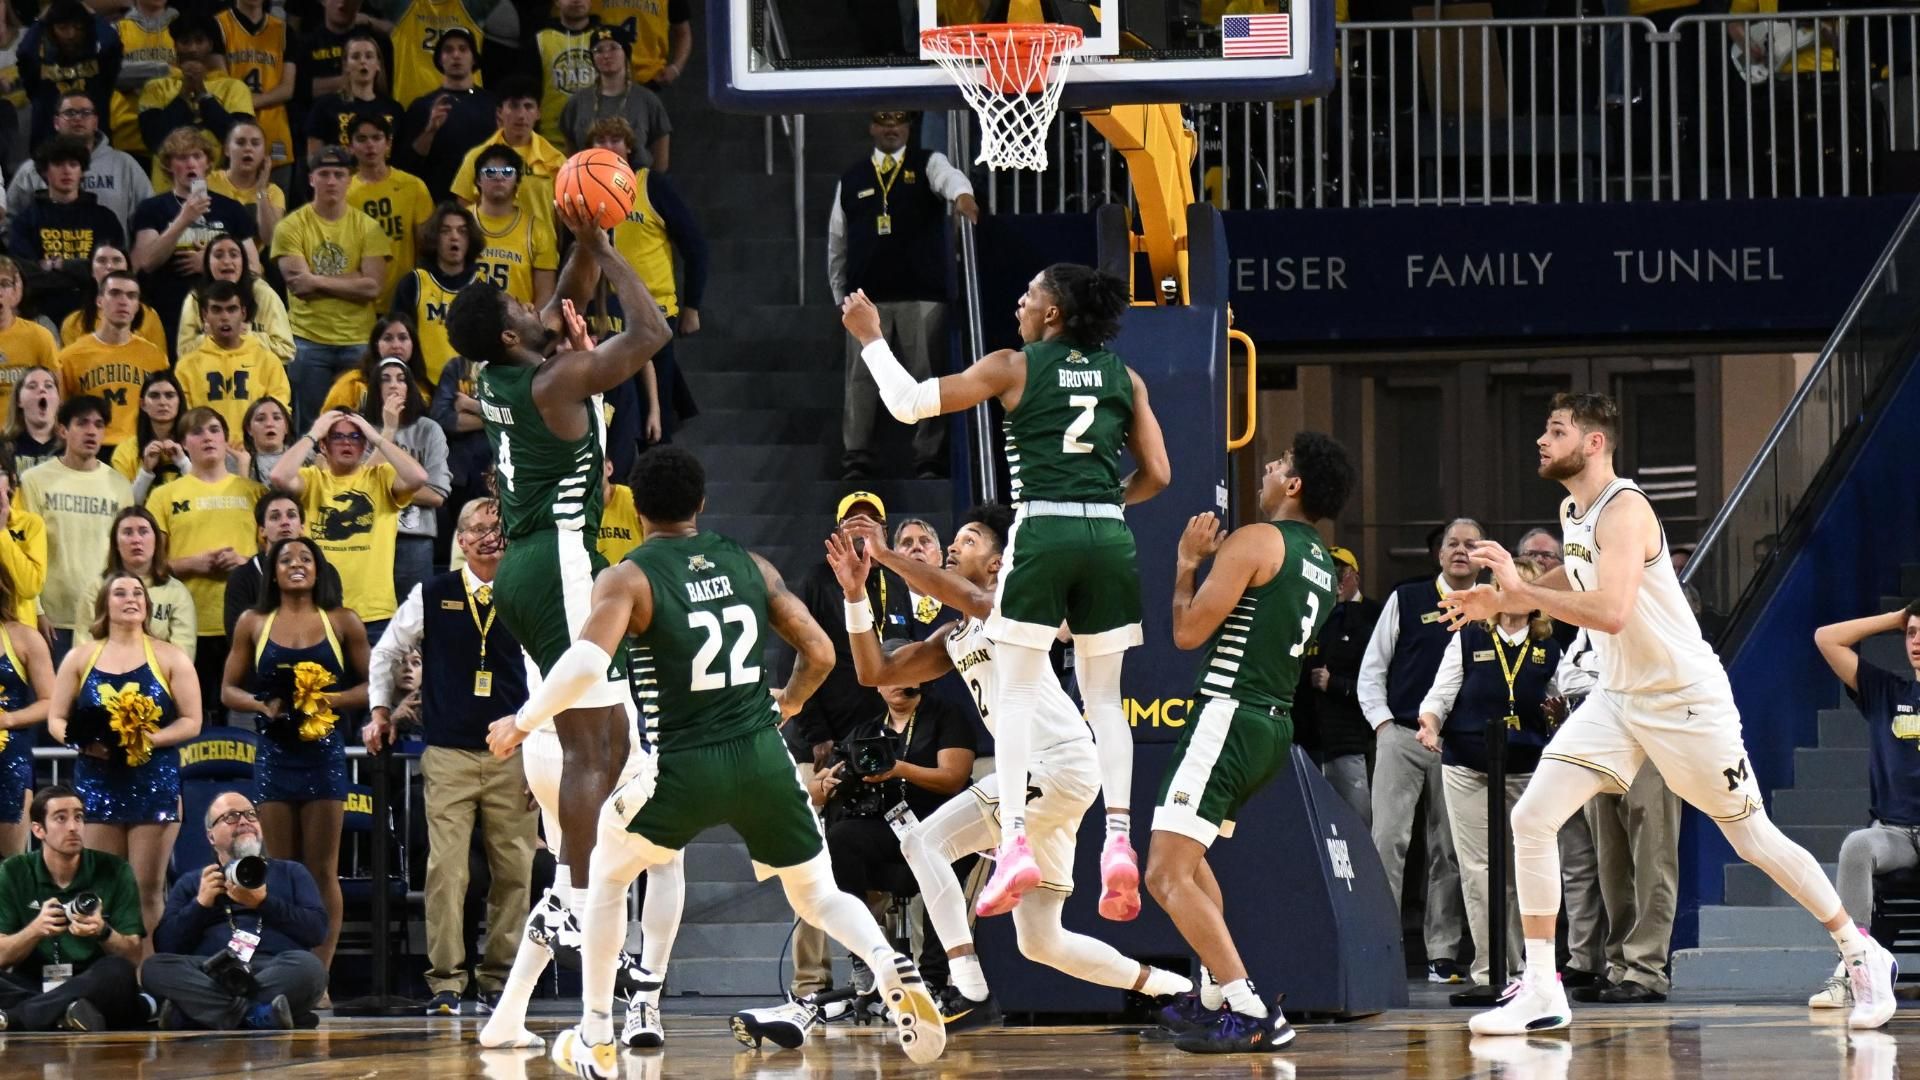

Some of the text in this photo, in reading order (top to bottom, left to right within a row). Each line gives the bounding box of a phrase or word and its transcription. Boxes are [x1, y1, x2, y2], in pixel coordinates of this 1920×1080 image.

[243, 67, 263, 94] 4
[40, 228, 94, 241] GO BLUE
[1229, 247, 1783, 291] EISER FAMILY TUNNEL
[206, 370, 250, 401] M
[1058, 368, 1103, 388] BROWN
[103, 387, 128, 406] M
[1062, 394, 1099, 454] 2
[45, 492, 119, 516] MICHIGAN
[172, 500, 191, 515] M
[8, 529, 26, 543] M
[598, 526, 632, 540] IGAN
[685, 575, 734, 603] BAKER
[1289, 591, 1320, 658] 3
[687, 603, 761, 692] 22
[970, 678, 990, 718] 2
[179, 740, 257, 768] MICHIGAN
[1722, 757, 1750, 792] M
